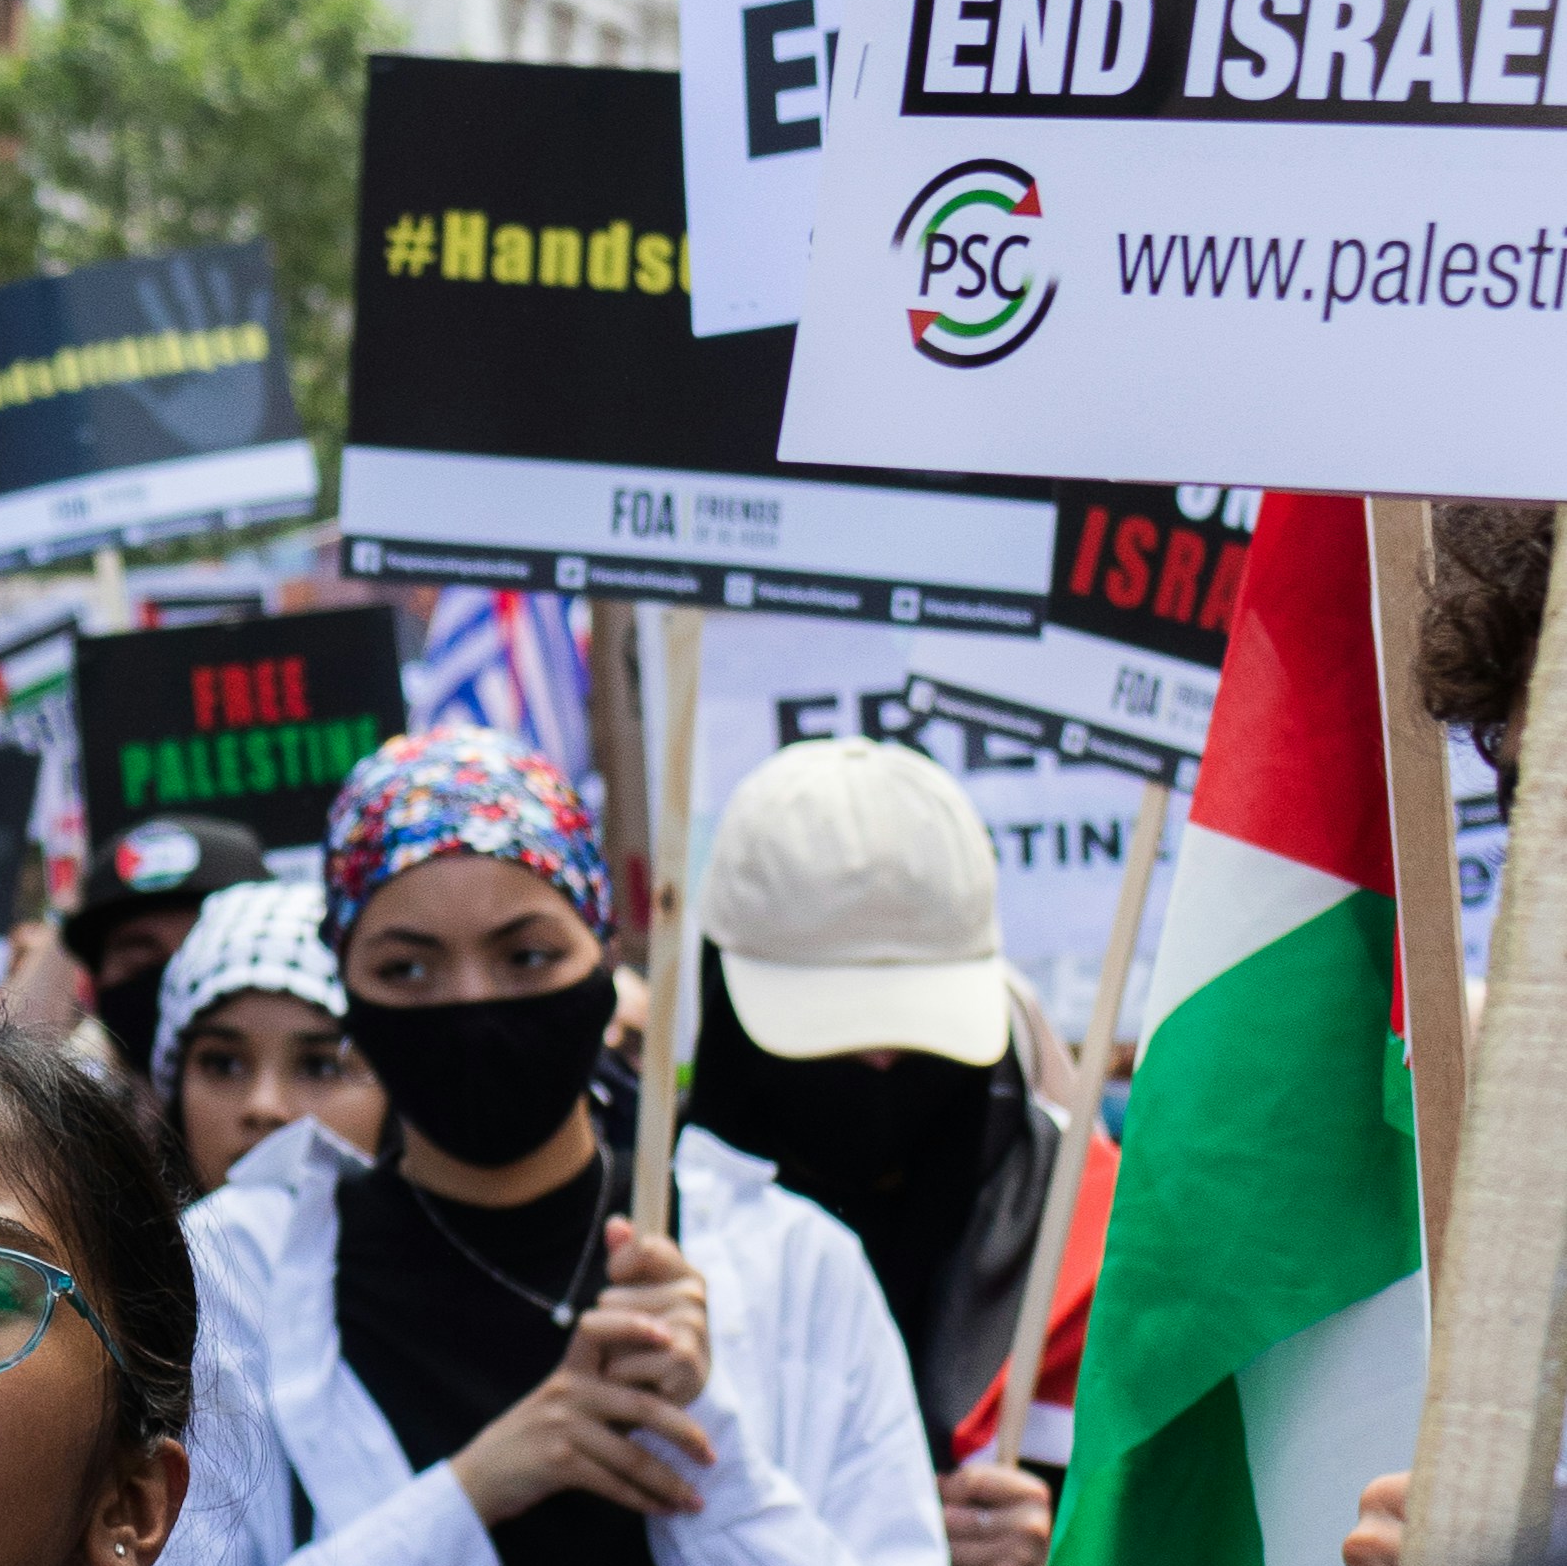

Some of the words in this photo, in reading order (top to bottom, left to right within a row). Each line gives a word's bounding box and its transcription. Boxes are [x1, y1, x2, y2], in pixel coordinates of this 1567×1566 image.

[383, 206, 692, 296] #Hands
[918, 232, 1032, 301] PSC
[611, 486, 676, 540] FOA
